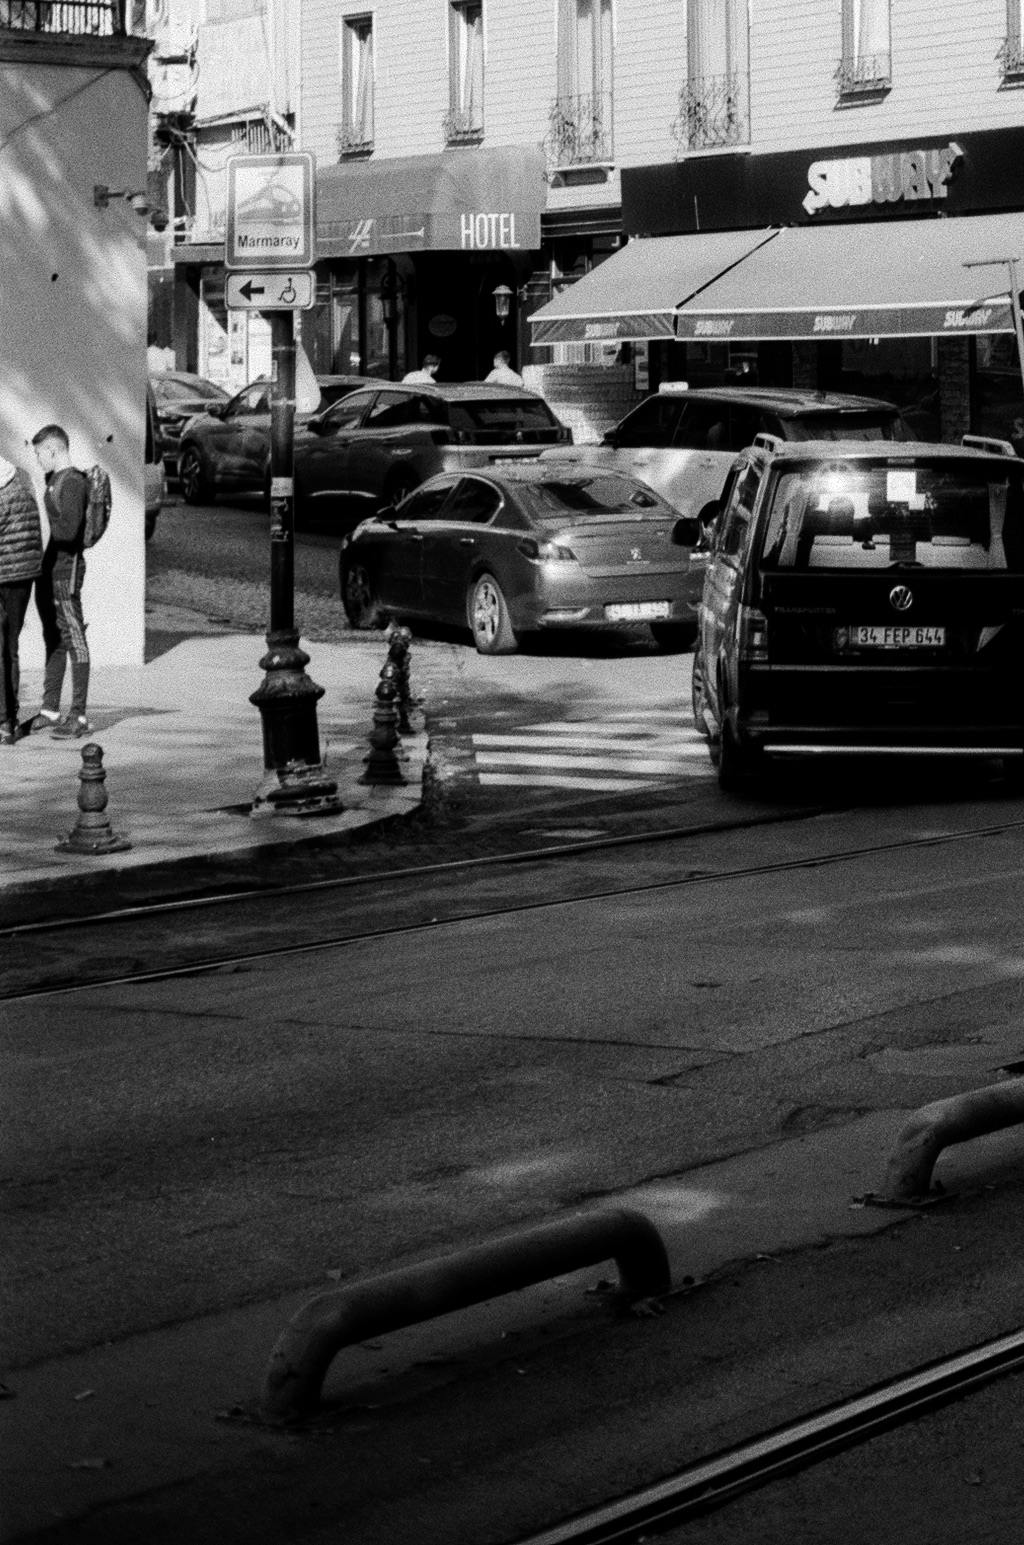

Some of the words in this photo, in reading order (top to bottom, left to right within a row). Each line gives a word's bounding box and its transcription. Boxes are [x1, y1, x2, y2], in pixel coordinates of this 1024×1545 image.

[802, 142, 964, 215] SUBWAY
[237, 234, 301, 251] Marmaray
[460, 213, 521, 249] HOTEL
[860, 627, 877, 644] 34
[884, 627, 910, 644] FEP
[915, 627, 942, 644] 644
